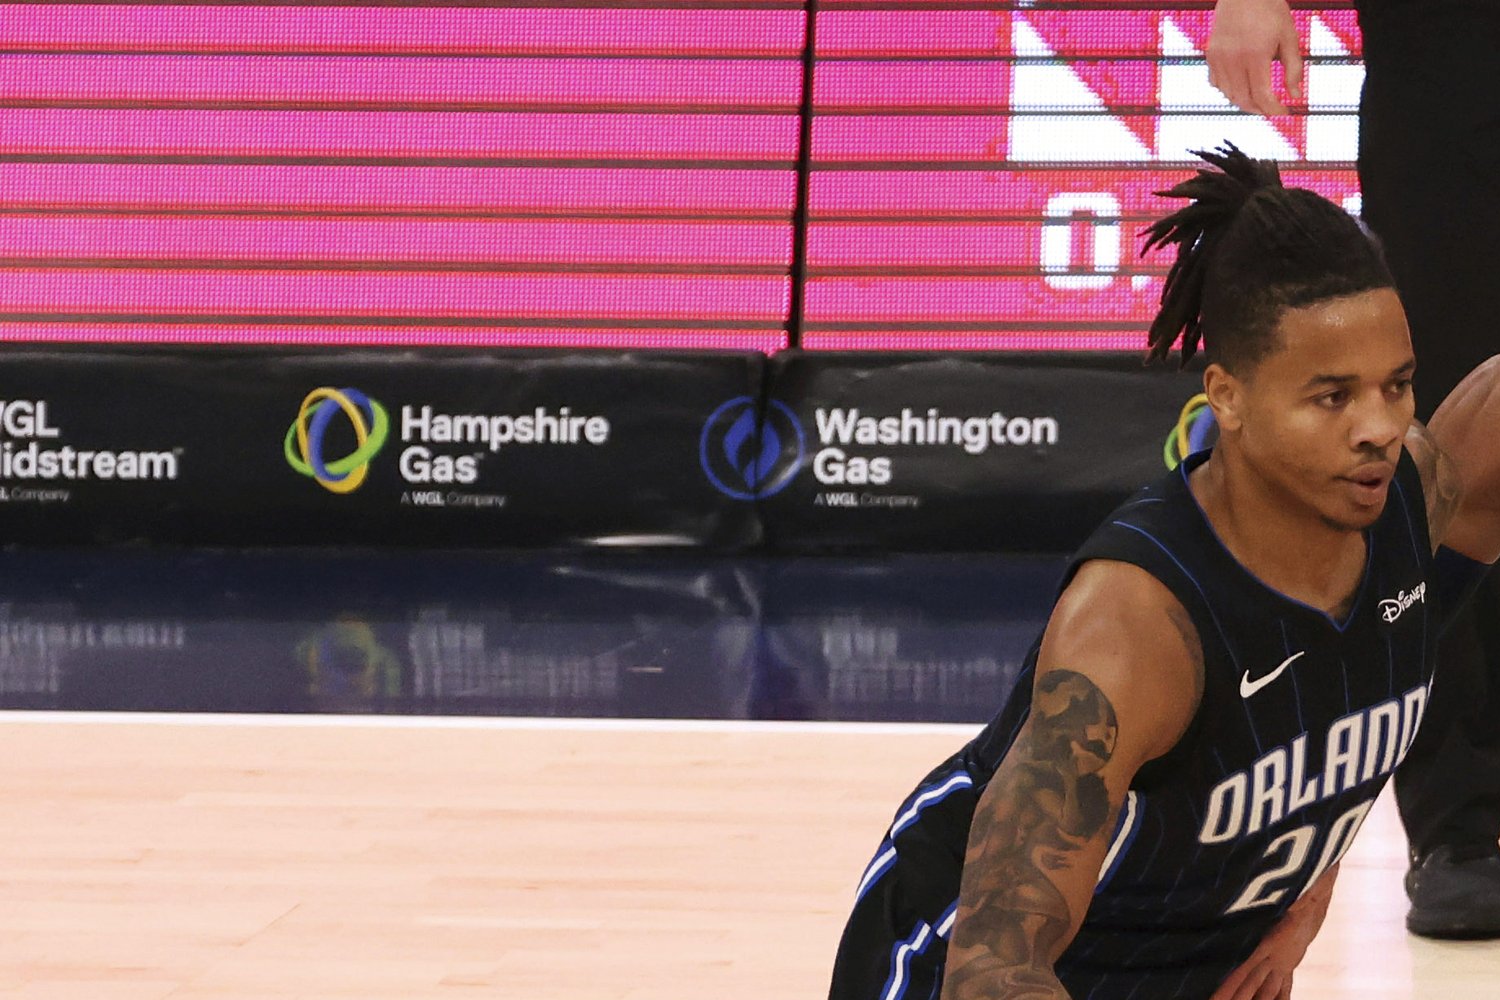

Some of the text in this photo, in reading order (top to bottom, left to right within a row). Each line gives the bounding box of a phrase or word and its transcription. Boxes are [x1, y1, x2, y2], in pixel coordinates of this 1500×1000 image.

[0, 400, 60, 437] GL
[401, 405, 610, 452] Hampshire
[815, 408, 1059, 454] Washington
[0, 441, 178, 480] idstream
[399, 445, 478, 483] Gas
[813, 447, 892, 485] Gas
